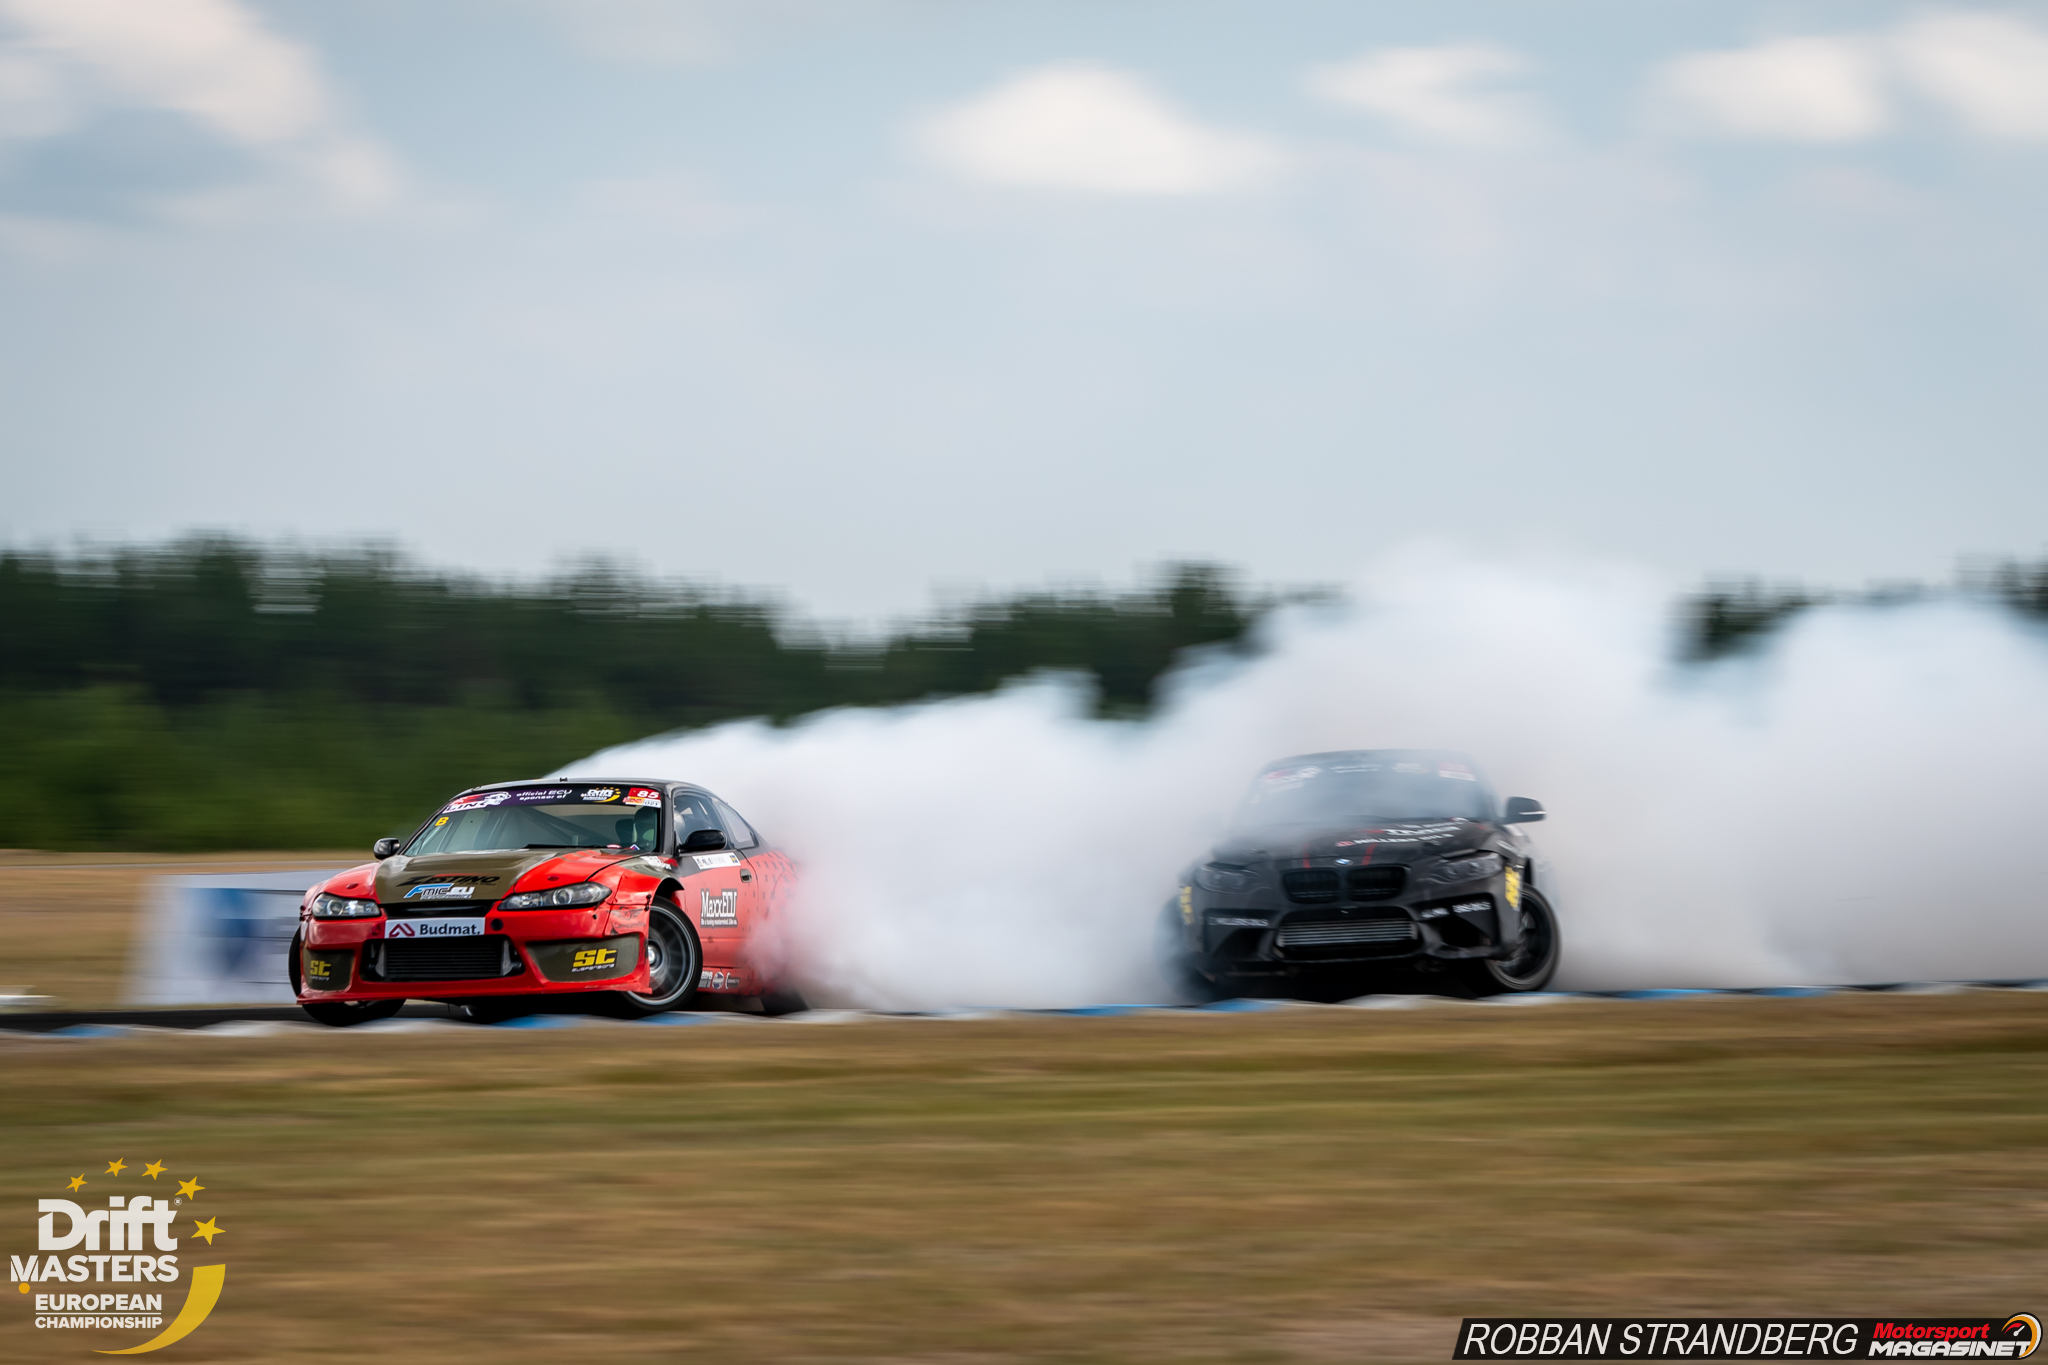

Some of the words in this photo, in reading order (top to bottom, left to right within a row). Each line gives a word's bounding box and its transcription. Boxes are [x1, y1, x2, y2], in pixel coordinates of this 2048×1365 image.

[637, 790, 660, 799] 85
[435, 817, 449, 826] B
[701, 891, 738, 918] MaxxECU
